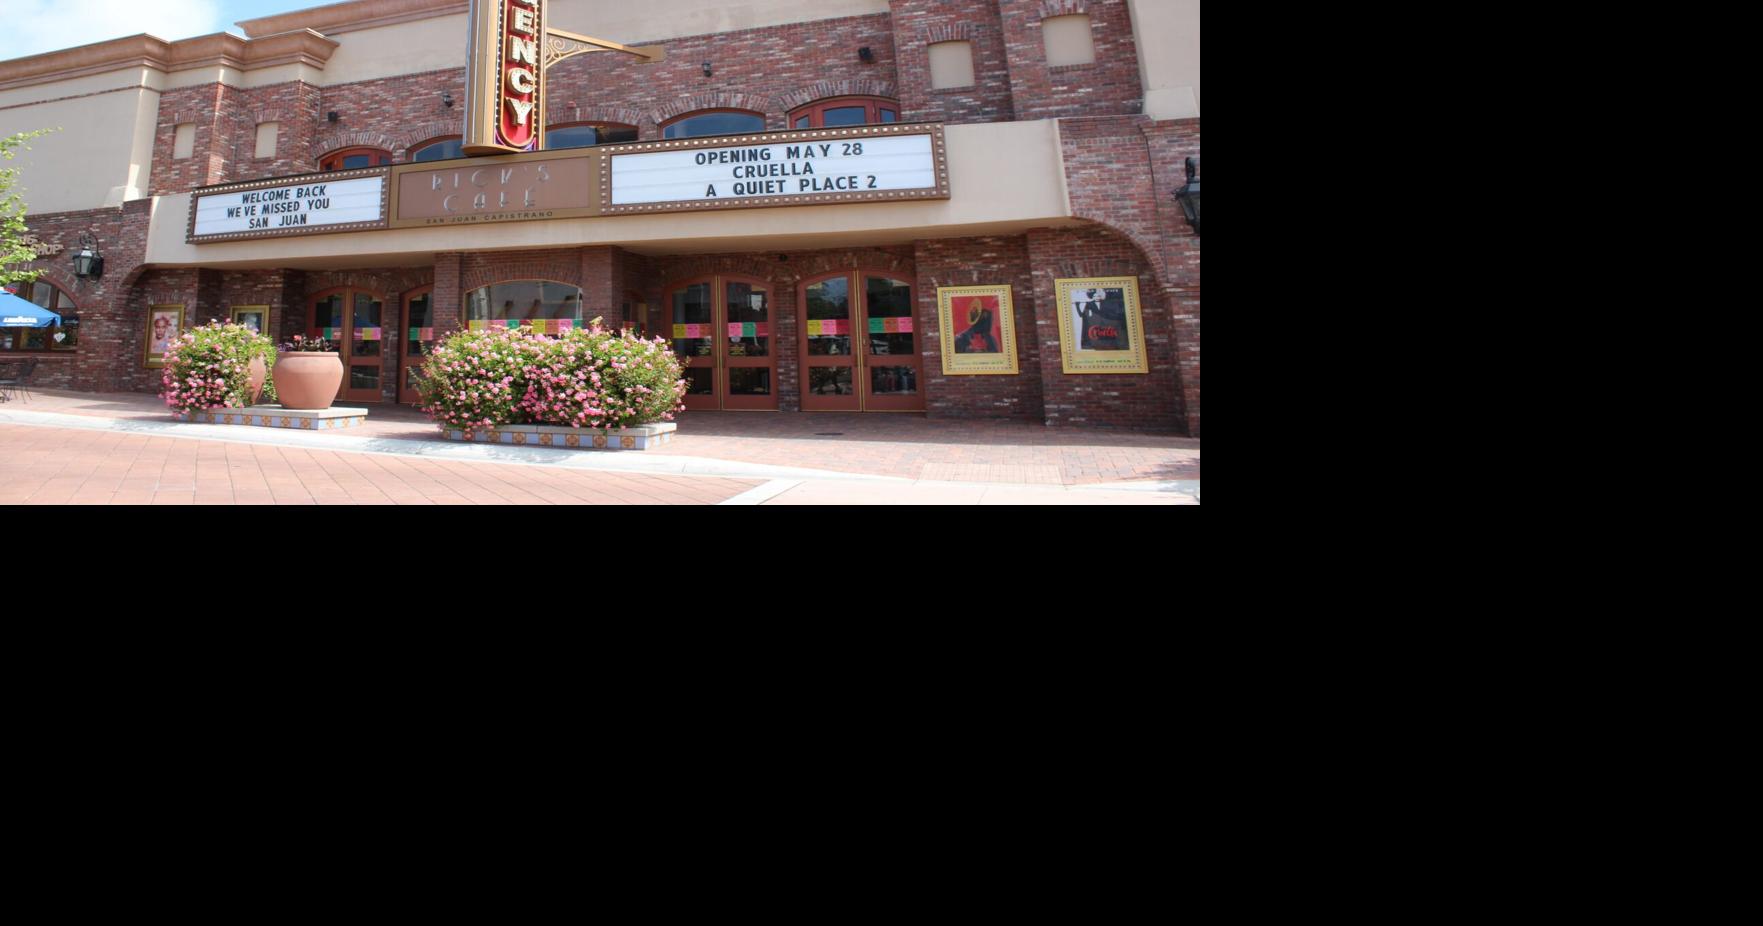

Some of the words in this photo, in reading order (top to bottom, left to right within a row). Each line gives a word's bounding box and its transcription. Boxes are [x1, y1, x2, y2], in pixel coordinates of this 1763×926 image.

[695, 148, 771, 165] OPENING
[786, 144, 831, 160] MAY
[842, 143, 863, 156] 28
[733, 162, 814, 179] CRUELLA
[242, 189, 290, 203] WELCOME
[297, 185, 326, 198] BACK
[706, 184, 717, 197] A
[733, 180, 786, 195] QUIET
[799, 176, 858, 191] PLACE
[867, 175, 877, 189] 2
[262, 202, 300, 214] MISSED
[308, 198, 330, 209] YOU
[249, 218, 269, 228] SAN
[279, 214, 307, 226] JUAN
[484, 211, 553, 221] CAPISTRANO
